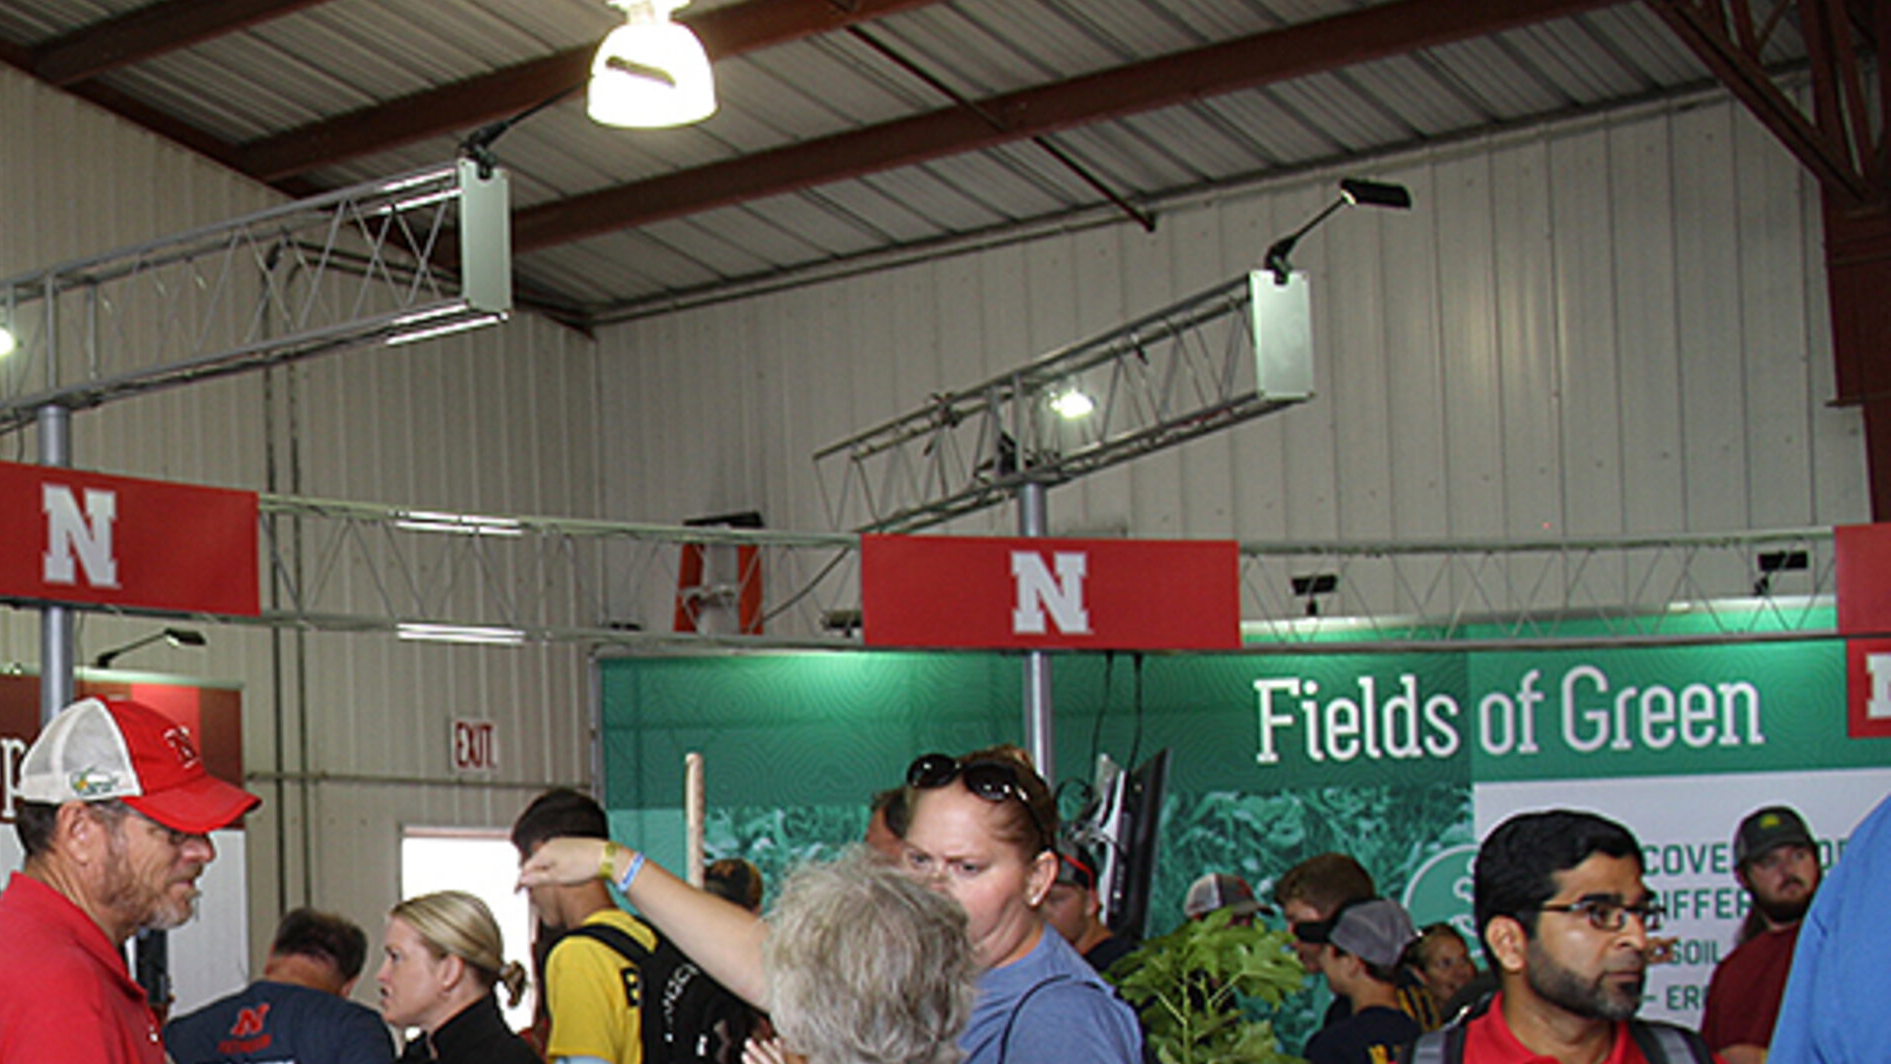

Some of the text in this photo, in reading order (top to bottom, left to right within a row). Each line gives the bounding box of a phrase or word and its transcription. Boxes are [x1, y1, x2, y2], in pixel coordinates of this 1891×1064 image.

[41, 481, 122, 590] N
[1010, 550, 1094, 635] N
[454, 721, 493, 768] EXIT
[1253, 673, 1460, 764] Fields
[1477, 669, 1544, 755] of
[1561, 665, 1766, 752] Green
[1641, 843, 1728, 875] COVE
